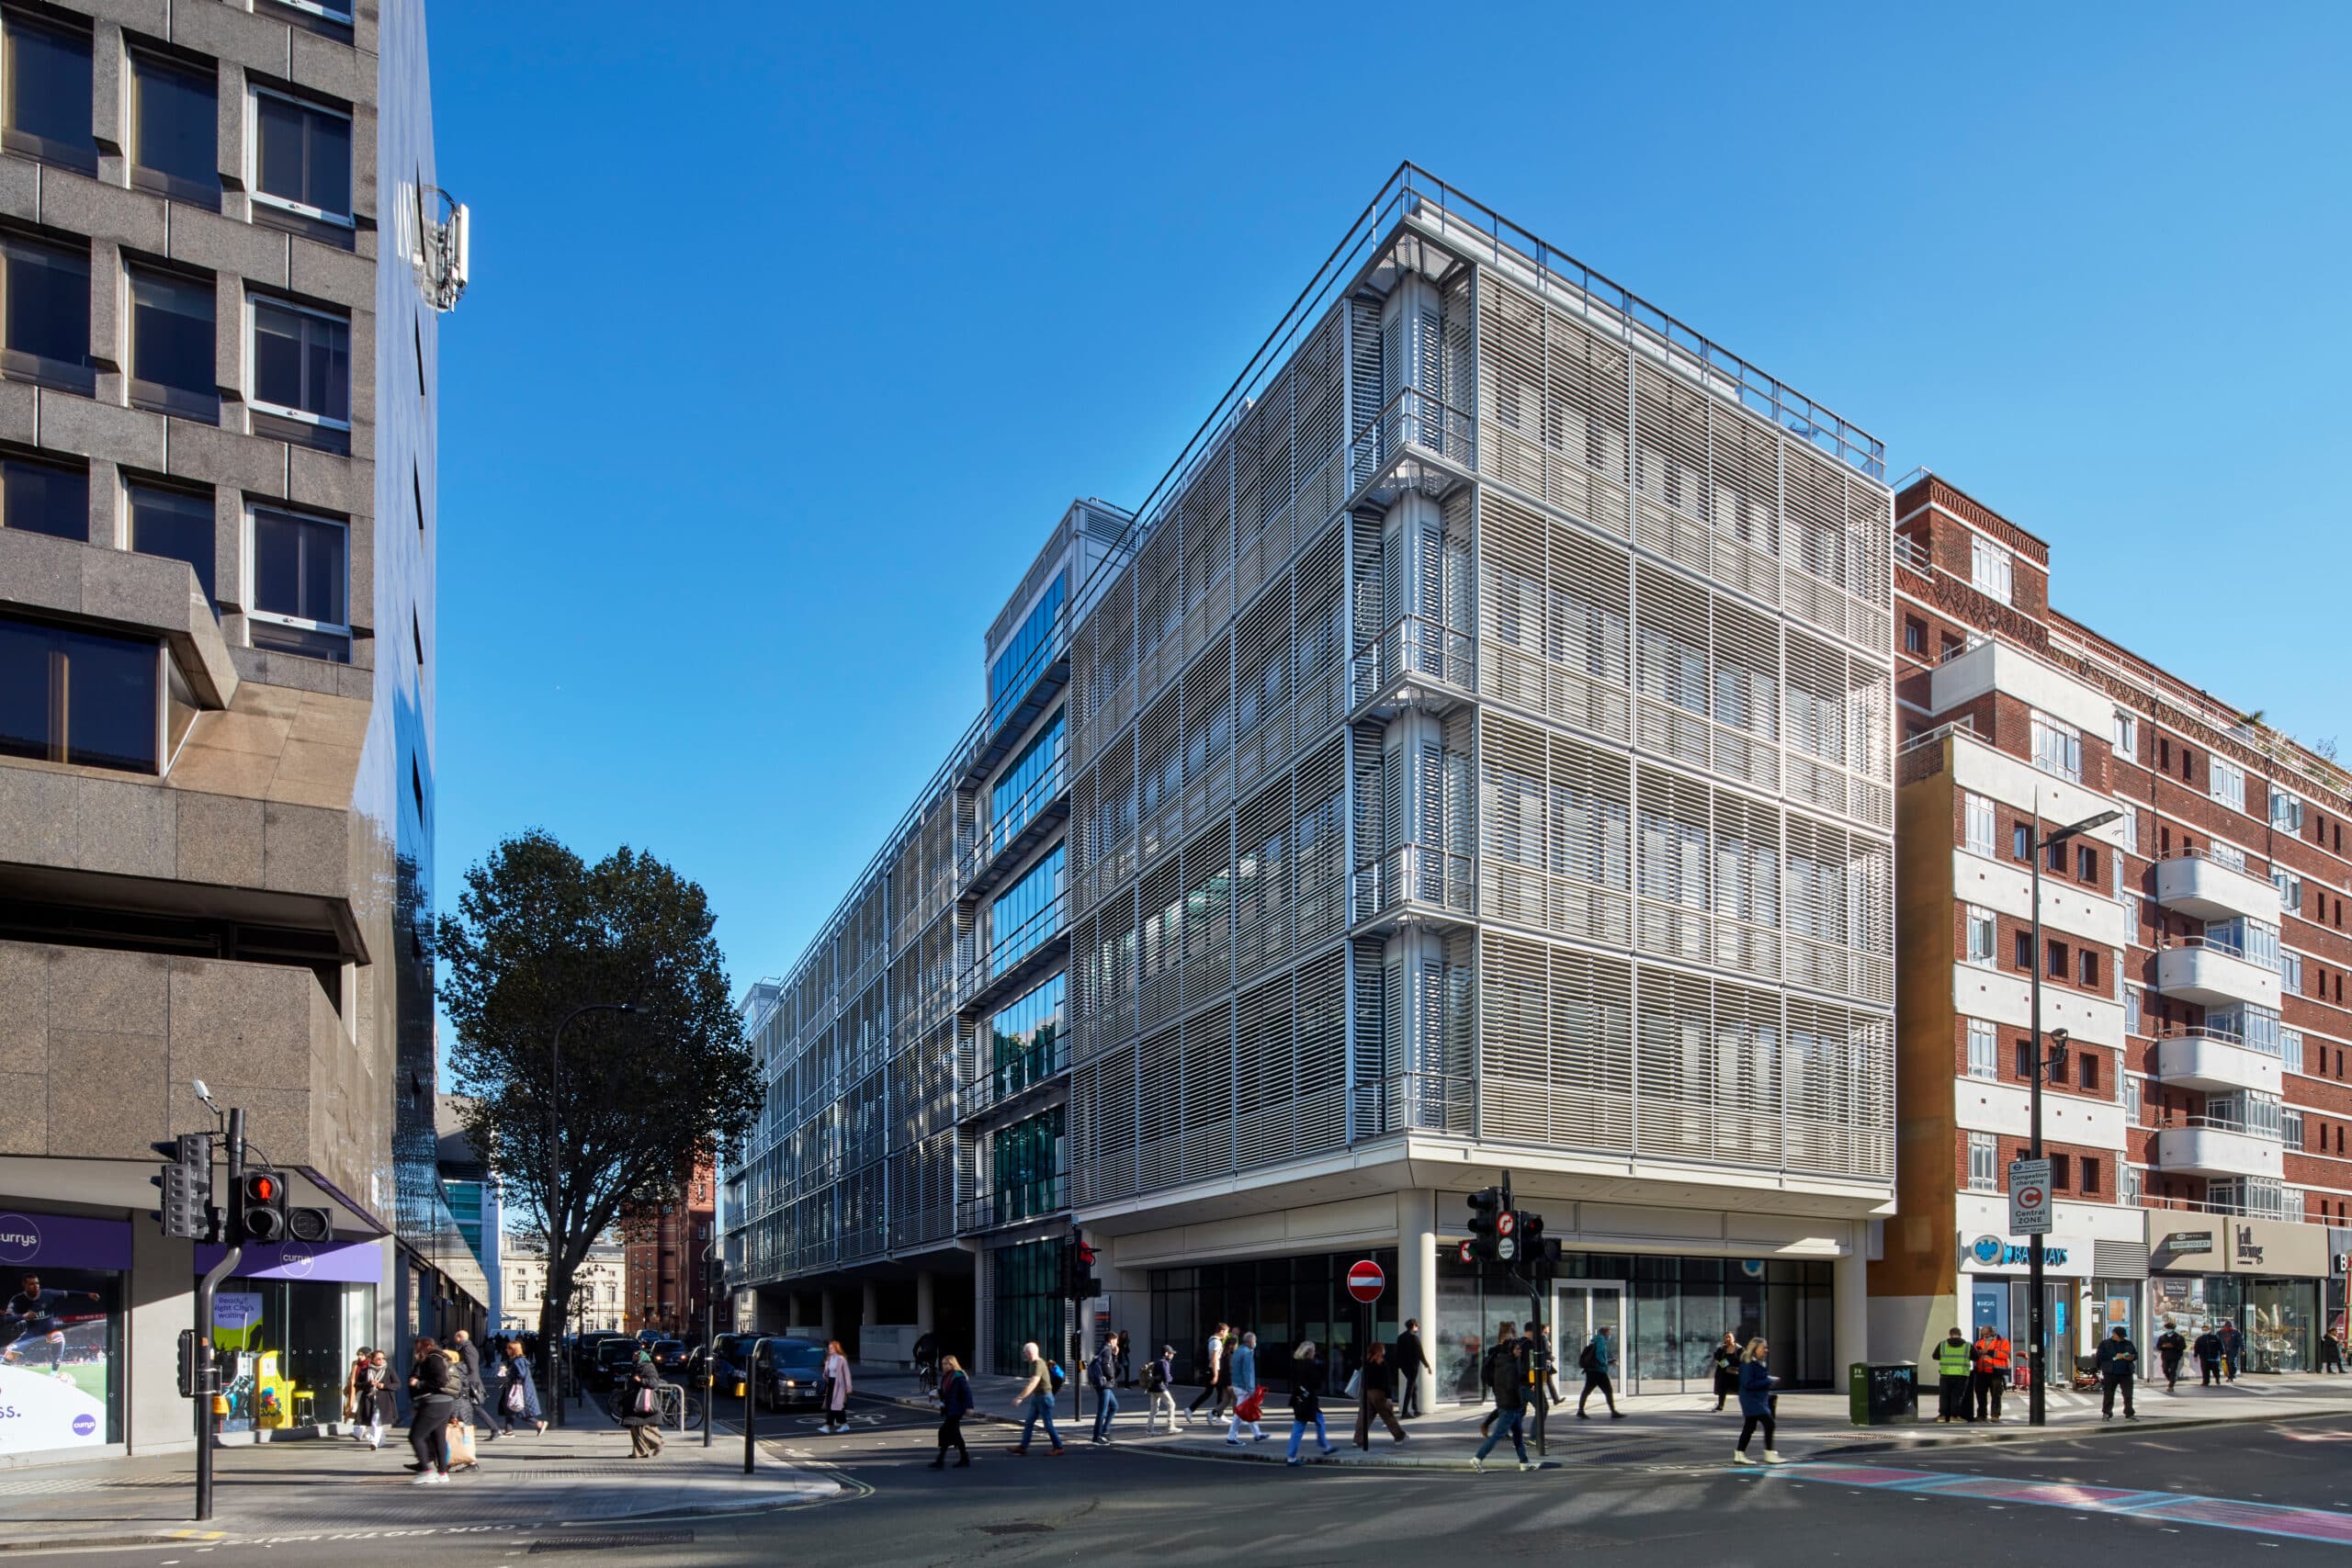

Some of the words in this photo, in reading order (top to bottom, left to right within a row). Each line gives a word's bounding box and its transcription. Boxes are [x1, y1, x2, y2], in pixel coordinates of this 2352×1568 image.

[2011, 1172, 2049, 1181] Congestion
[2015, 1209, 2046, 1217] Central
[2018, 1216, 2042, 1224] ZONE
[0, 1233, 37, 1247] urrys
[282, 1254, 311, 1265] currys
[2014, 1245, 2068, 1264] BALAYS
